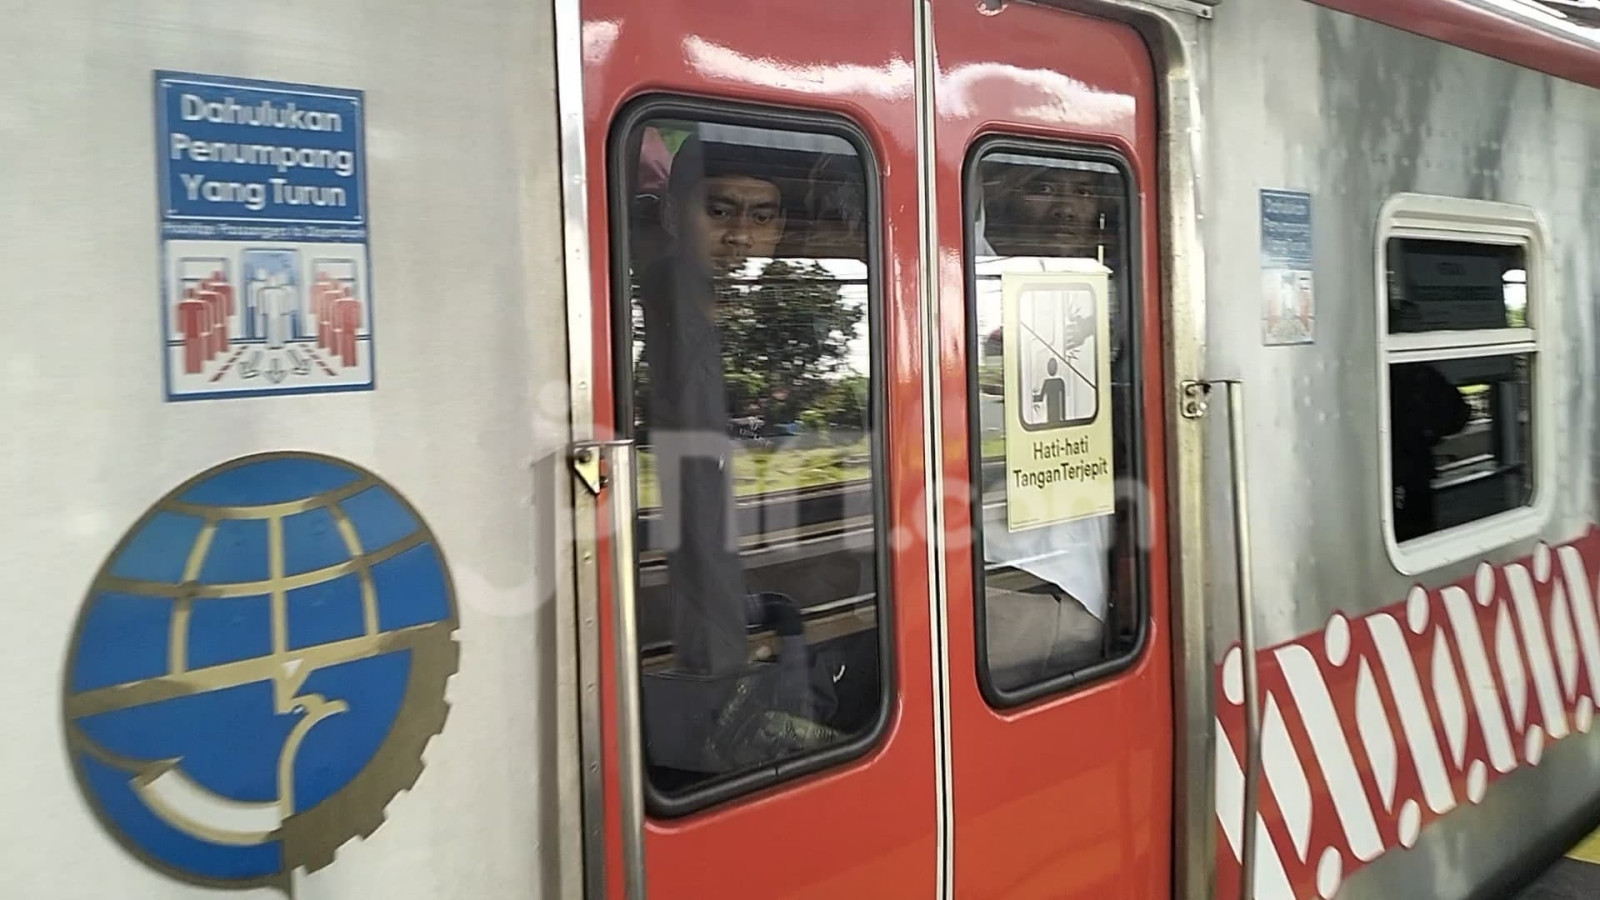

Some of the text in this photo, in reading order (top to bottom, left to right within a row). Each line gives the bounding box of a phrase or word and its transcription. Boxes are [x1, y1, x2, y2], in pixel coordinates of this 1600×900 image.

[180, 93, 343, 132] Dahulukan
[170, 133, 354, 177] Penumpang
[179, 173, 347, 210] Yang Turun
[1033, 435, 1089, 460] Hati-hati
